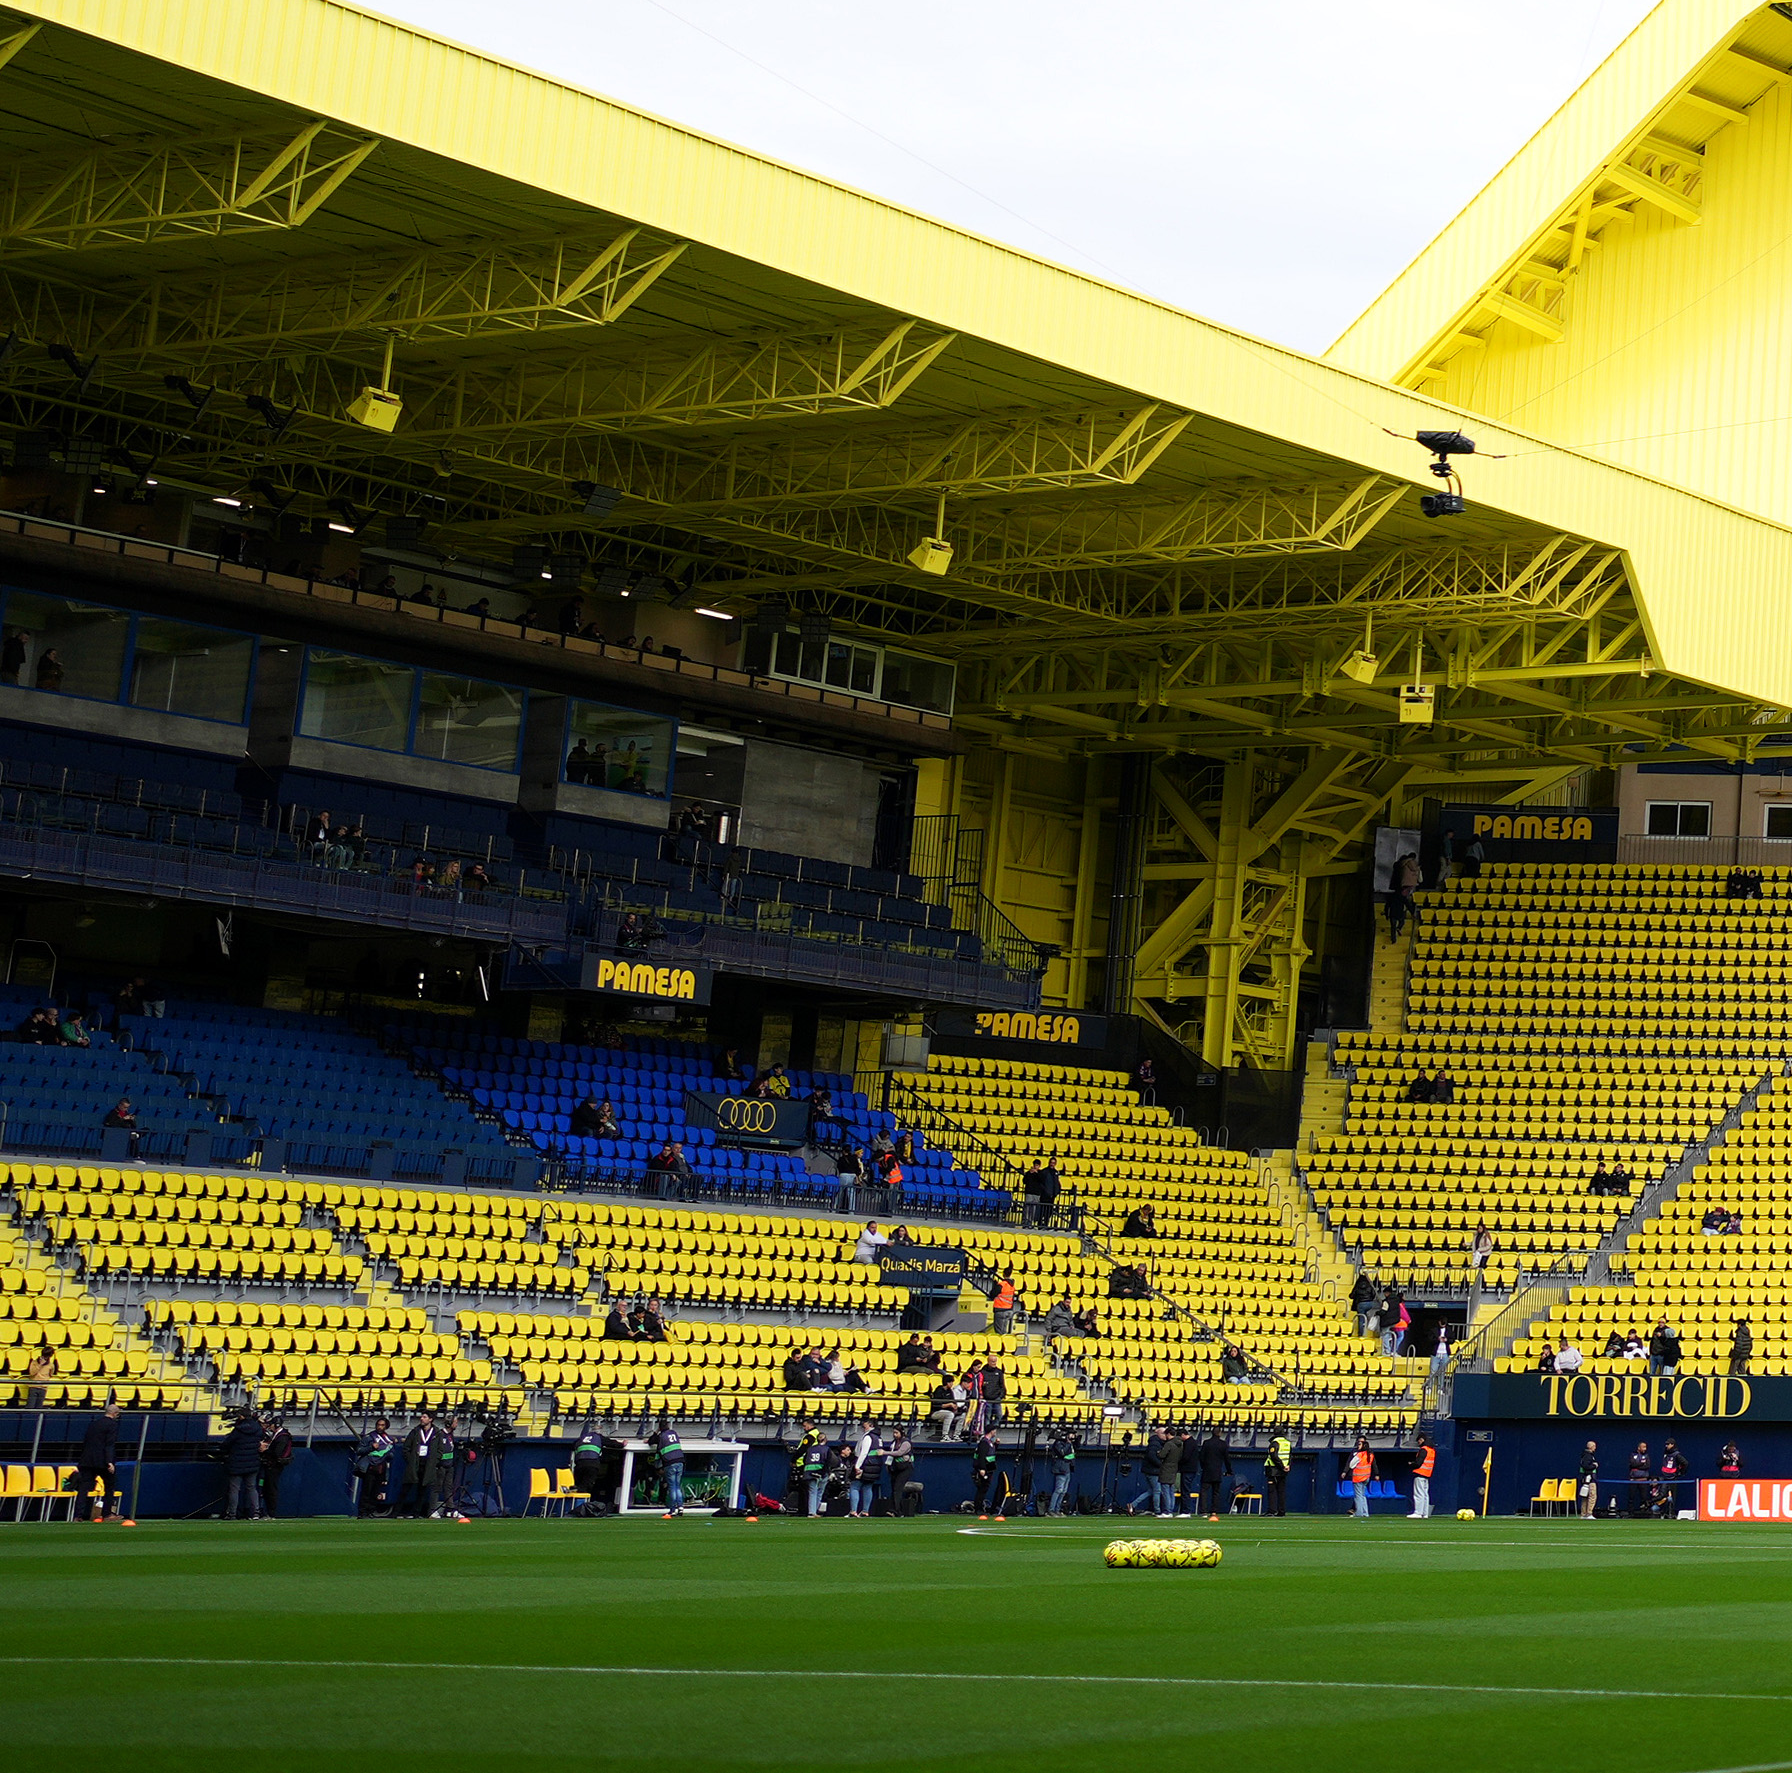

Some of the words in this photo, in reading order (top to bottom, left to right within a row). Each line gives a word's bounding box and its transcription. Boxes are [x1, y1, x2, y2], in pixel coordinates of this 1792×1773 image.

[1474, 815, 1592, 840] PAMESA
[597, 959, 696, 999] PAMESA
[974, 1012, 1080, 1044] PAMESA
[881, 1256, 923, 1272] Quadis
[925, 1258, 960, 1274] Marzá
[1540, 1375, 1752, 1418] TORRECID
